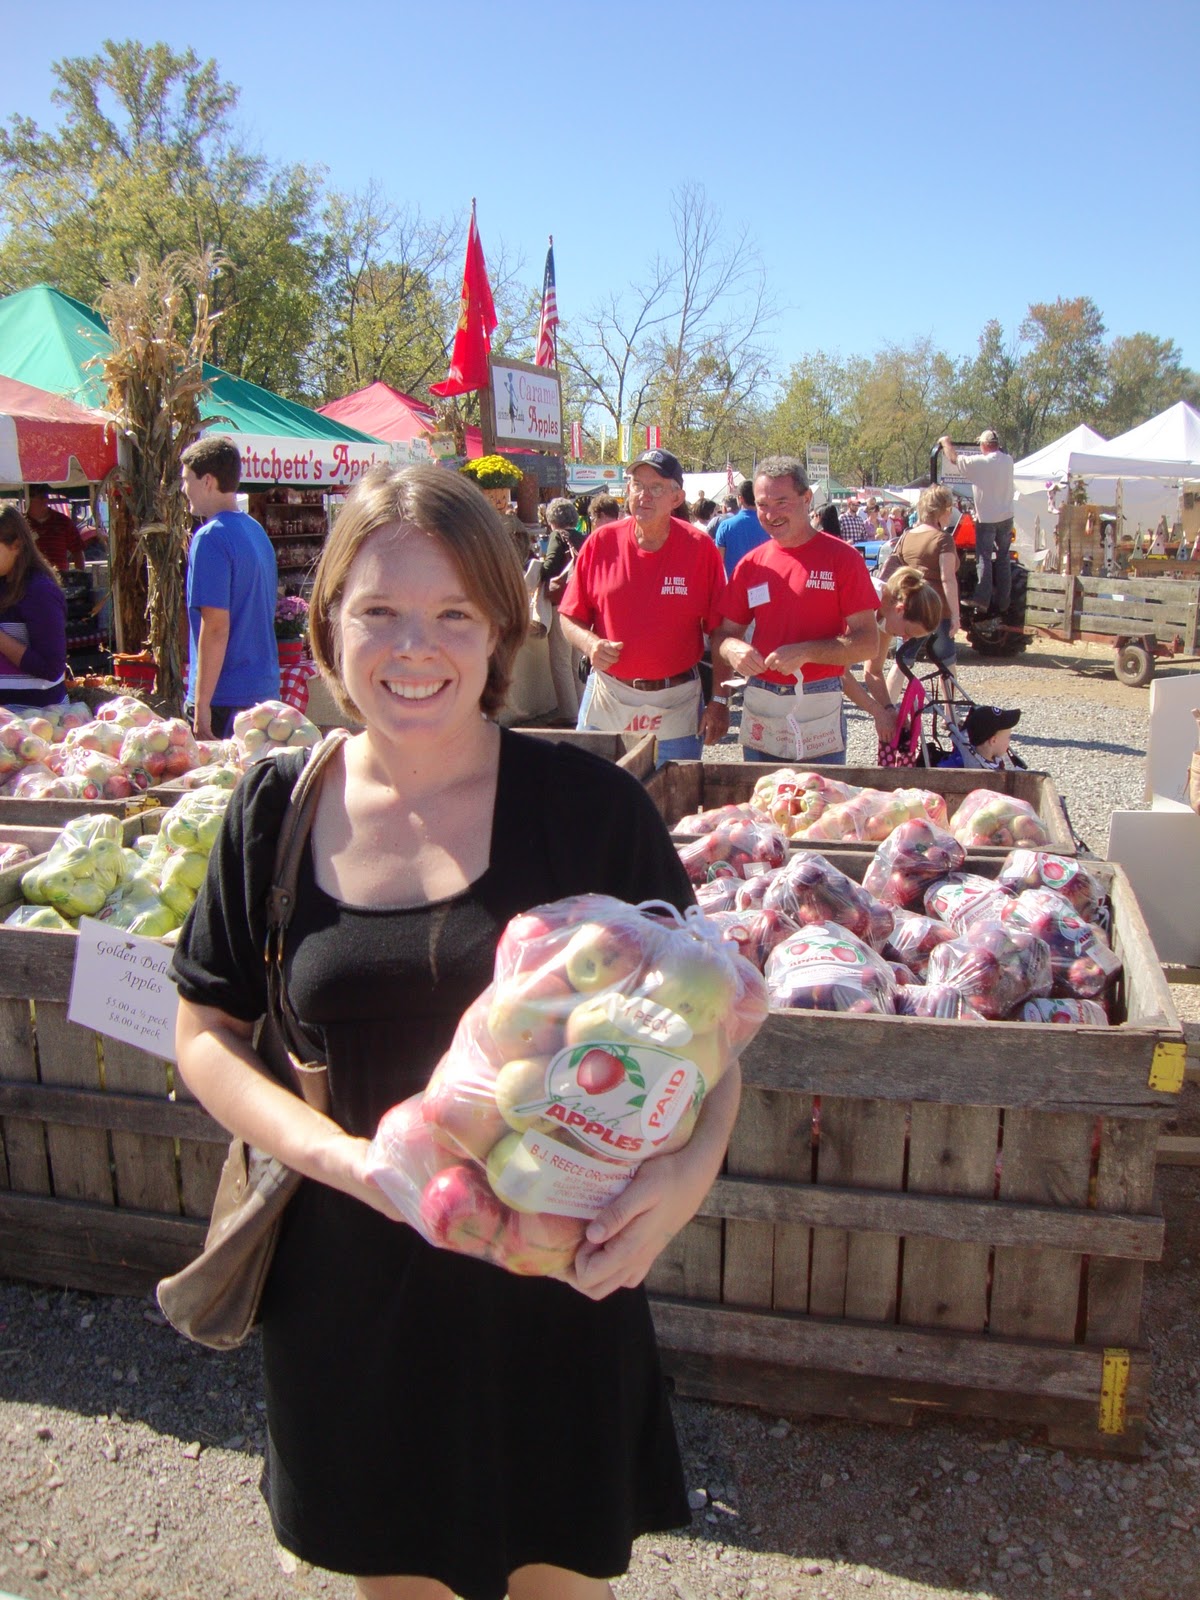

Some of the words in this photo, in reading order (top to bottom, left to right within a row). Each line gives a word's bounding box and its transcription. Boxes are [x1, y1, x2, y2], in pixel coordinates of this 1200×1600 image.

[519, 376, 558, 406] Caramel
[528, 406, 559, 438] Apples
[240, 445, 322, 480] ritchett's
[806, 580, 820, 589] APPLE
[821, 581, 835, 590] HOUSE
[820, 571, 833, 580] REECE
[661, 586, 674, 595] APPLE
[675, 586, 688, 595] HOUSE
[624, 714, 662, 731] ACE
[813, 729, 835, 741] Festival
[97, 940, 138, 964] Golden
[119, 971, 163, 994] Apples
[105, 996, 130, 1013] $5.00
[109, 1012, 133, 1028] $8.00
[134, 1023, 139, 1031] a
[140, 1025, 161, 1040] peck
[633, 1011, 672, 1034] PECK
[648, 1069, 685, 1128] PAID
[545, 1103, 645, 1152] APPLES
[530, 1144, 548, 1162] B.J.
[550, 1154, 585, 1177] REECE
